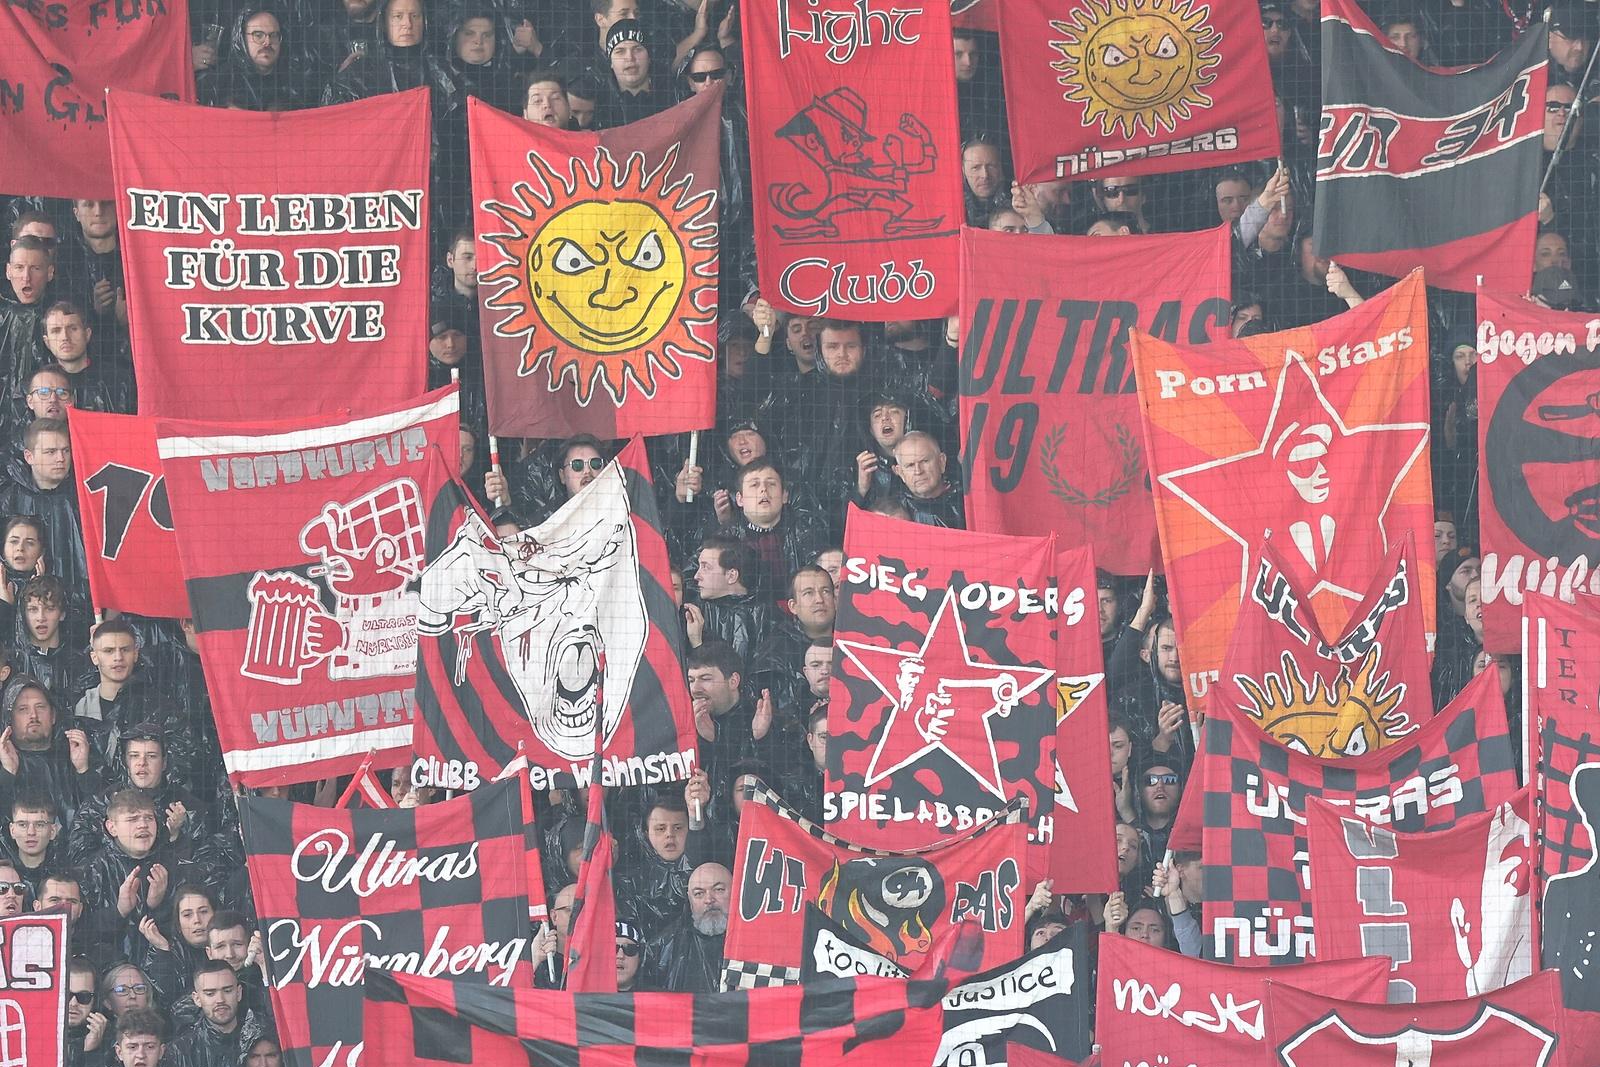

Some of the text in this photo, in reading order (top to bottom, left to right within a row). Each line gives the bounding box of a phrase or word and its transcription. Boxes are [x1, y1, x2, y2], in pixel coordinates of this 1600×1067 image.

[128, 189, 424, 236] EIN LEBEN
[164, 244, 401, 290] FÜR DIE
[181, 301, 385, 345] KURVE
[1155, 326, 1415, 400] Porn Stars
[845, 557, 928, 602] SIEG
[529, 764, 562, 792] er
[291, 828, 480, 896] Ultras
